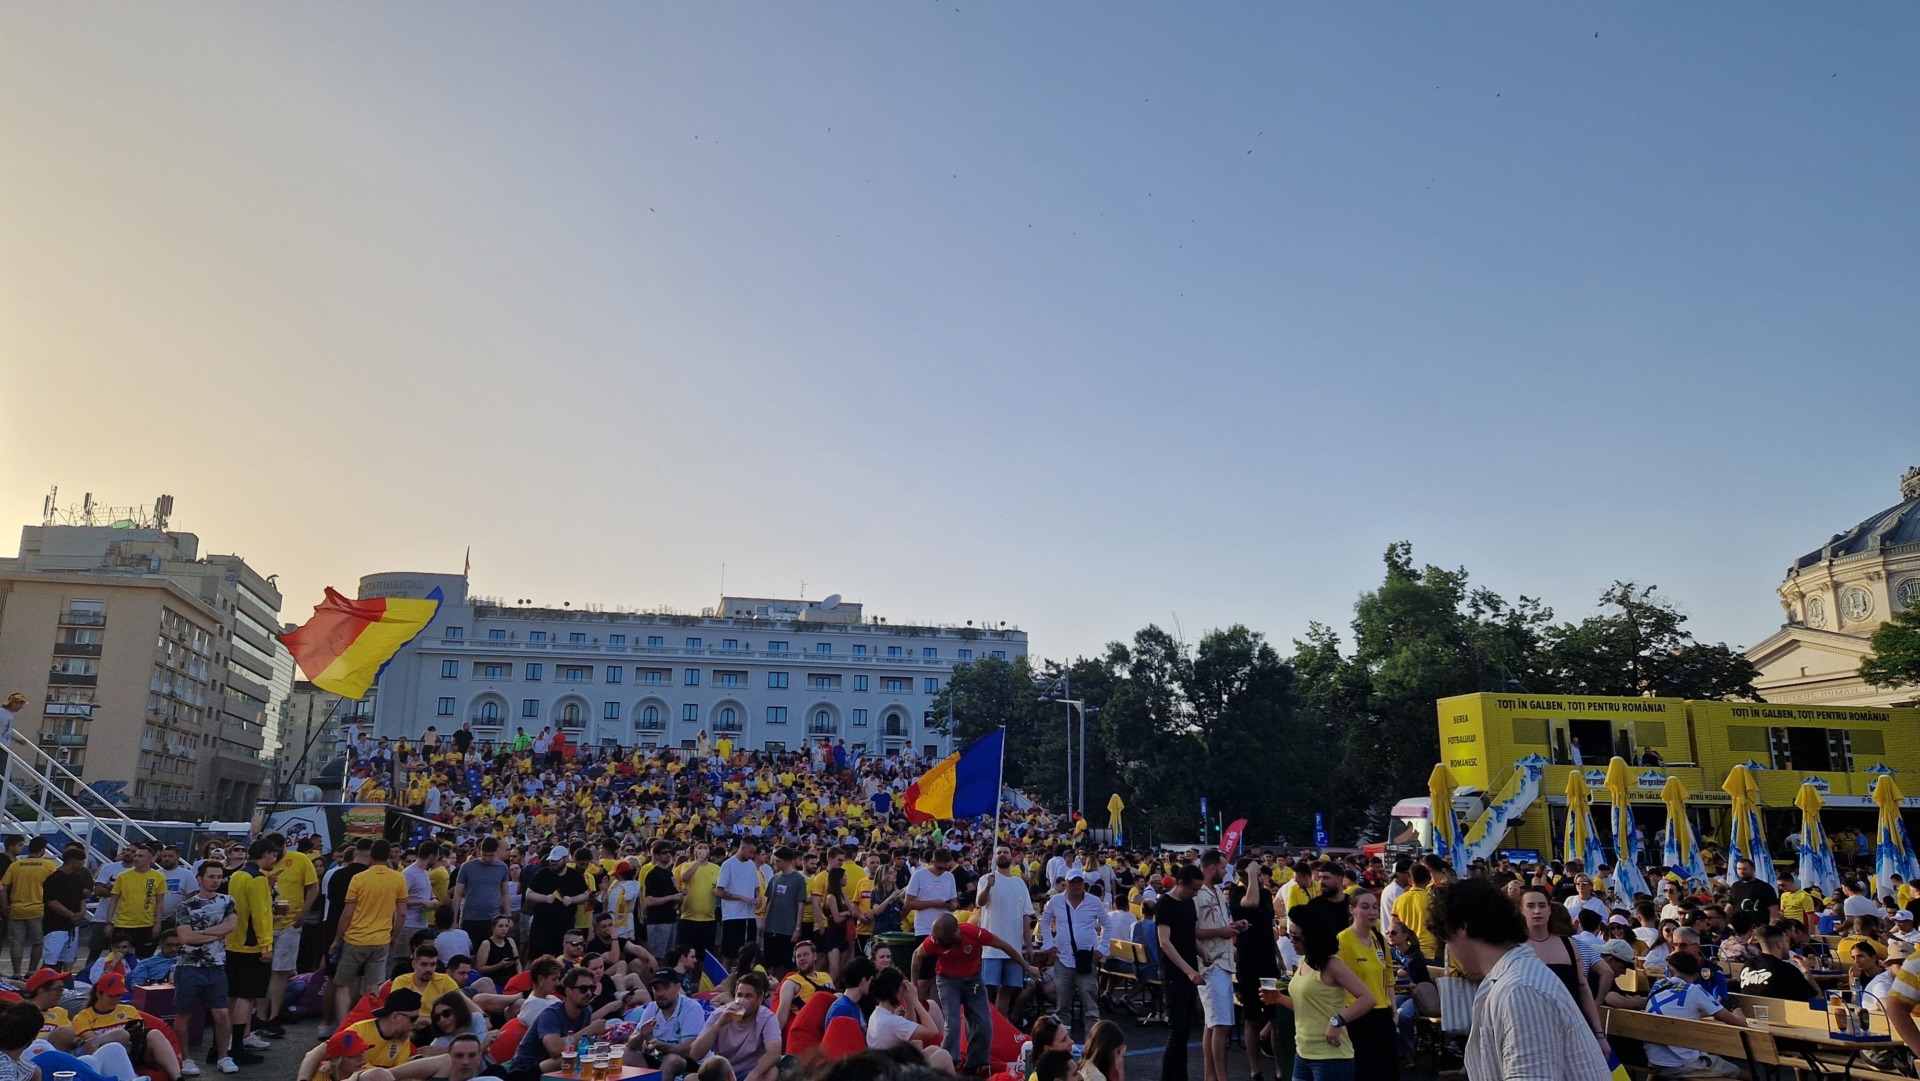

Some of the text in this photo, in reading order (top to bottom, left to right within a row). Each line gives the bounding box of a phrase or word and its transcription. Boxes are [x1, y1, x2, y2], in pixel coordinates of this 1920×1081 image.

[1497, 697, 1666, 713] TOȚI ÎN GALBEN, TOȚI PENTRU ROMÂNIA!
[1453, 714, 1469, 724] BEREA
[1731, 706, 1890, 722] TOȚI ÎN GALBEN, TOȚI PENTRU ROMÂNIA!
[1447, 734, 1477, 745] FOTBALULUI
[1450, 757, 1478, 768] ROMÂNESC
[1317, 832, 1324, 842] P
